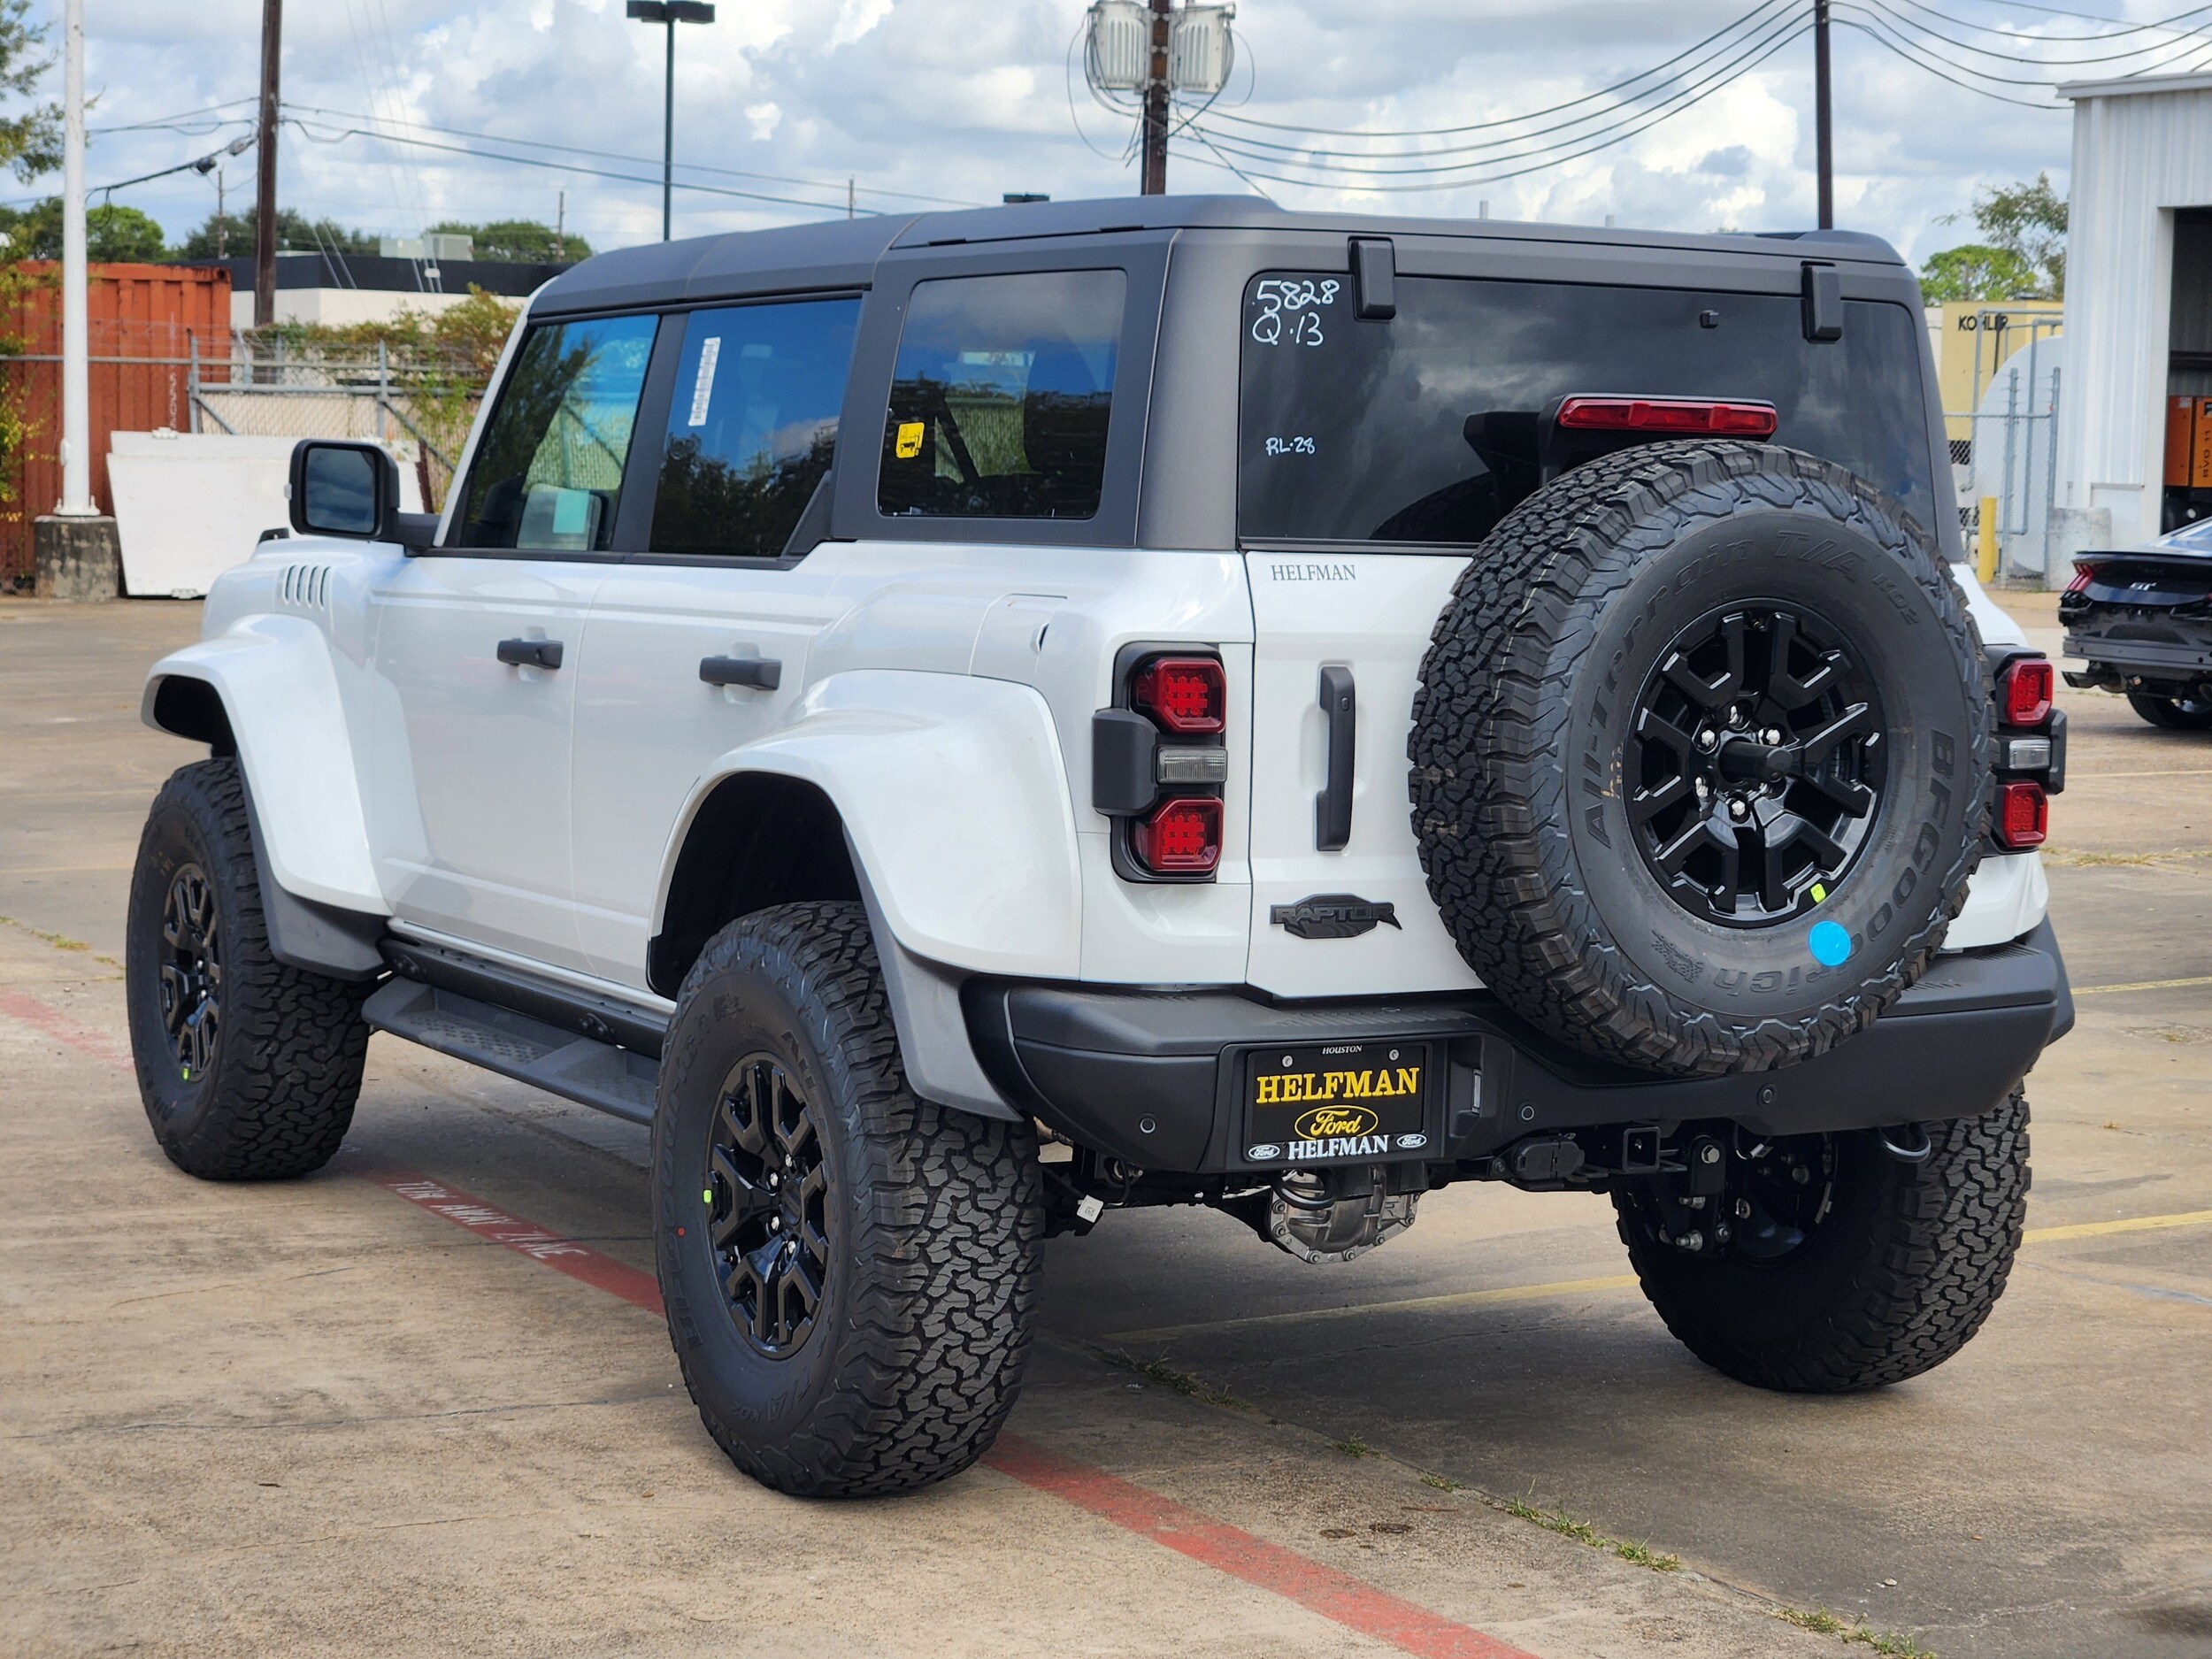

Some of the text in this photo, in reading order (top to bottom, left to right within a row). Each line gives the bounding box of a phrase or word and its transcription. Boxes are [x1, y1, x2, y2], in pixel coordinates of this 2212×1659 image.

[1256, 279, 1340, 313] 5828
[1271, 564, 1357, 581] HELFMAN
[1275, 904, 1394, 926] RAPTOR
[1322, 1045, 1363, 1055] HOUSTON
[1256, 1067, 1420, 1104] HELFMAN
[1310, 1109, 1363, 1136] Ford
[1287, 1134, 1390, 1161] HELFMAN
